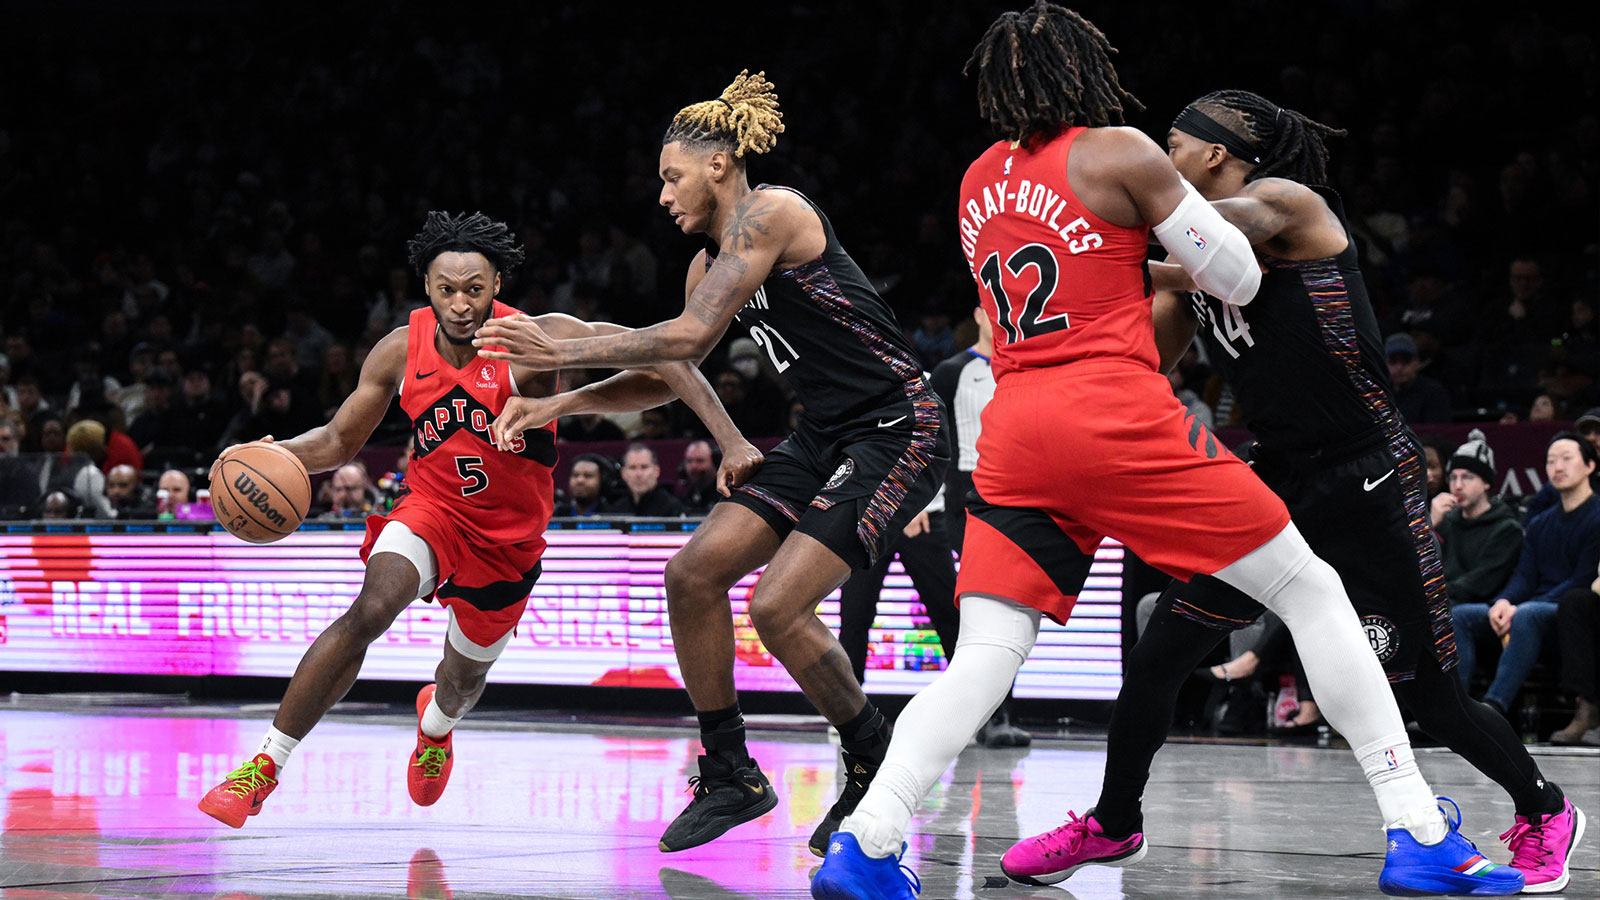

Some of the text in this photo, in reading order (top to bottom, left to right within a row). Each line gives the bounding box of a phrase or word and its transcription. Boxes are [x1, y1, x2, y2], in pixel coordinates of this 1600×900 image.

[961, 179, 1104, 279] URRAY-BOYLES
[979, 242, 1071, 345] 12
[749, 320, 800, 374] 21
[1207, 301, 1255, 359] 14
[476, 381, 498, 389] Sun Life
[234, 471, 287, 528] Wilson
[454, 456, 489, 497] 5
[51, 581, 151, 637] REAL
